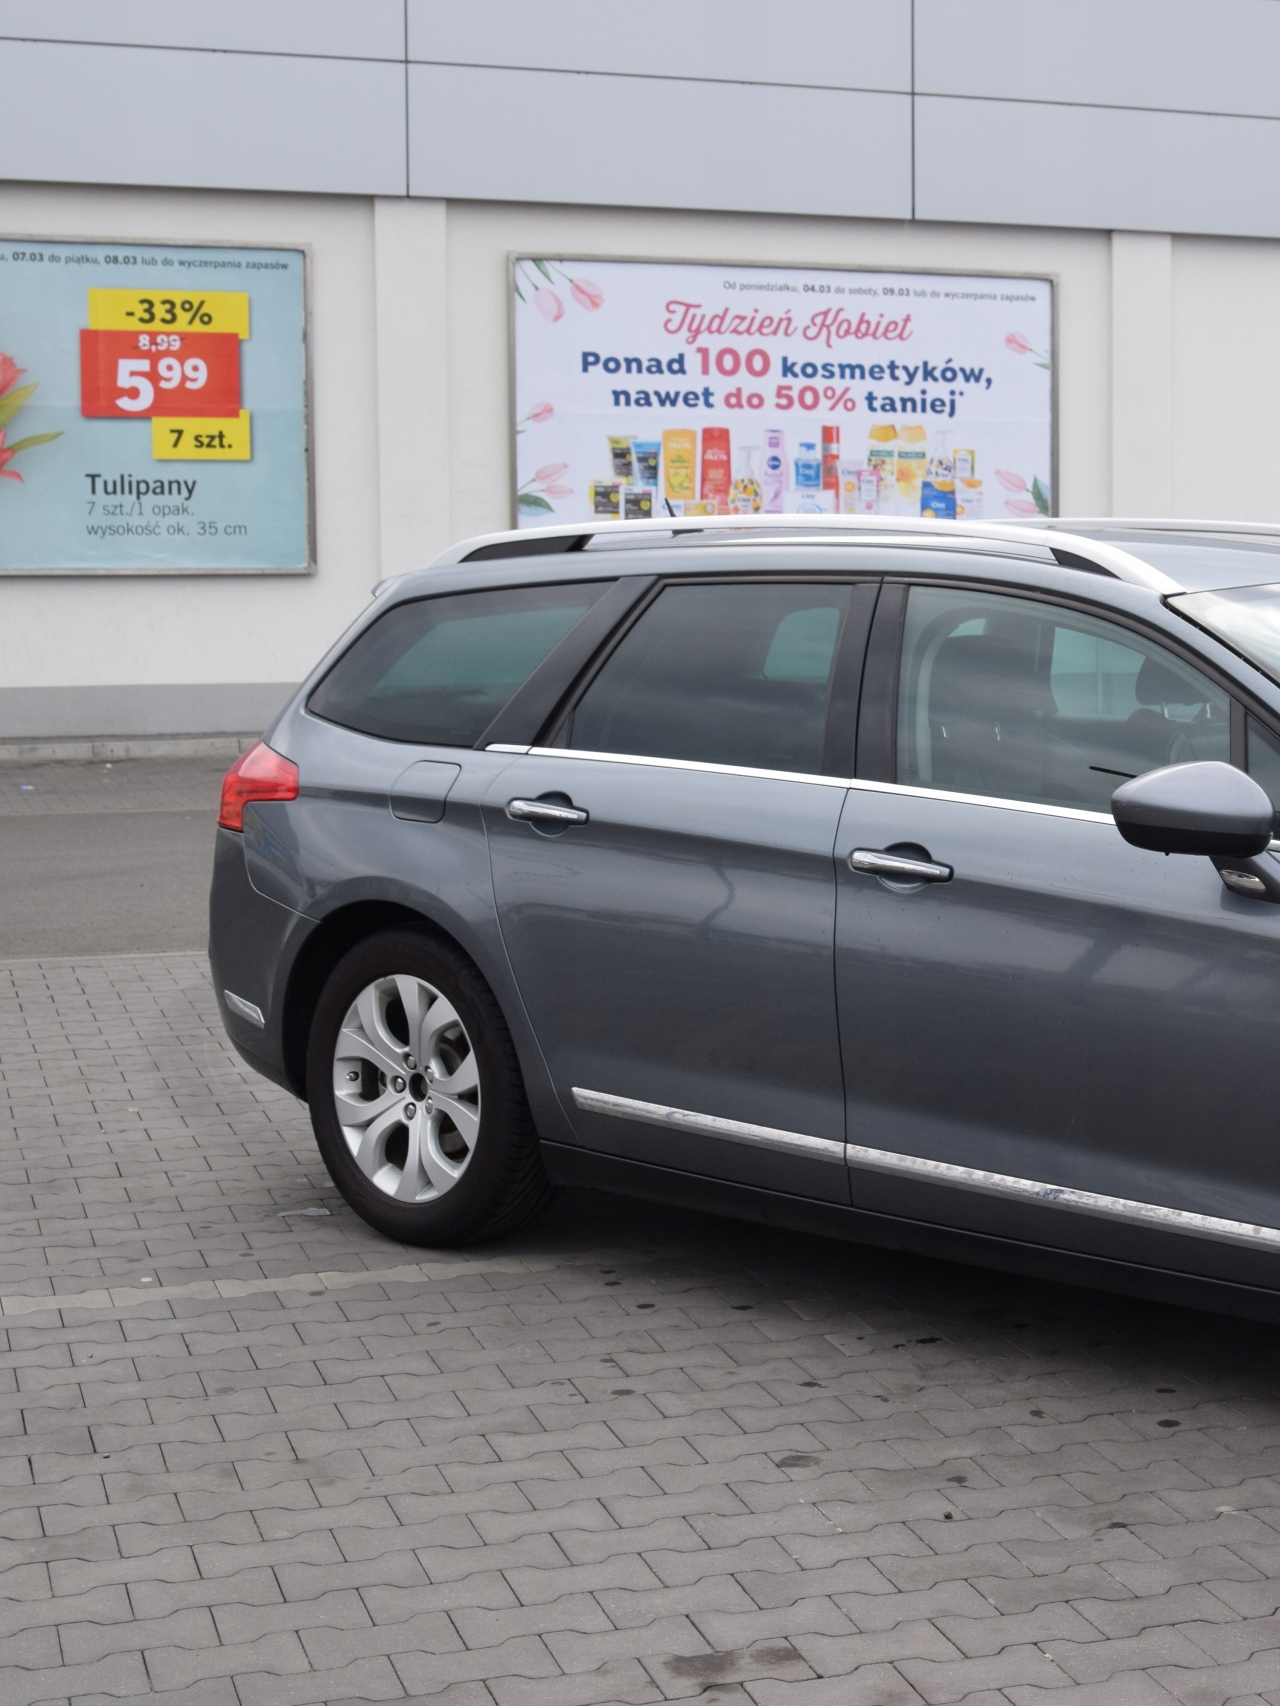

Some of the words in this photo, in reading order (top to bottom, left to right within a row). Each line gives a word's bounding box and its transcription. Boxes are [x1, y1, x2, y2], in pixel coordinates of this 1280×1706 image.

[12, 251, 44, 263] 07.03
[48, 253, 61, 263] do
[64, 253, 100, 266] piątku,
[104, 254, 137, 265] 08.03
[141, 256, 158, 266] lub
[161, 257, 174, 267] do
[178, 258, 242, 270] wyczerpania
[245, 259, 289, 271] zapasów
[723, 280, 737, 290] Od
[739, 282, 800, 294] poniedziałku,
[803, 284, 831, 294] 04.03
[834, 285, 845, 295] do
[882, 287, 910, 297] 09.03
[913, 288, 927, 298] lub
[930, 288, 941, 298] do
[943, 290, 998, 302] wyczerpania
[1000, 292, 1037, 303] zapasów
[125, 298, 213, 326] -33%
[663, 300, 797, 345] Tydzień
[802, 307, 914, 348] Kobiet
[137, 333, 182, 353] 8,99
[581, 350, 687, 375] Ponad
[696, 347, 771, 377] 100
[781, 356, 993, 390] kosmetyków,
[611, 386, 714, 408] nawet
[723, 387, 765, 410] do
[775, 385, 857, 412] 50%
[169, 428, 184, 448] 7
[193, 430, 233, 449] szt.
[85, 473, 197, 501] Tulipany
[86, 501, 96, 516] 7
[151, 502, 195, 518] opak.
[85, 521, 161, 539] wysokość
[166, 521, 190, 536] ok.
[196, 521, 218, 536] 35
[223, 524, 248, 536] cm
